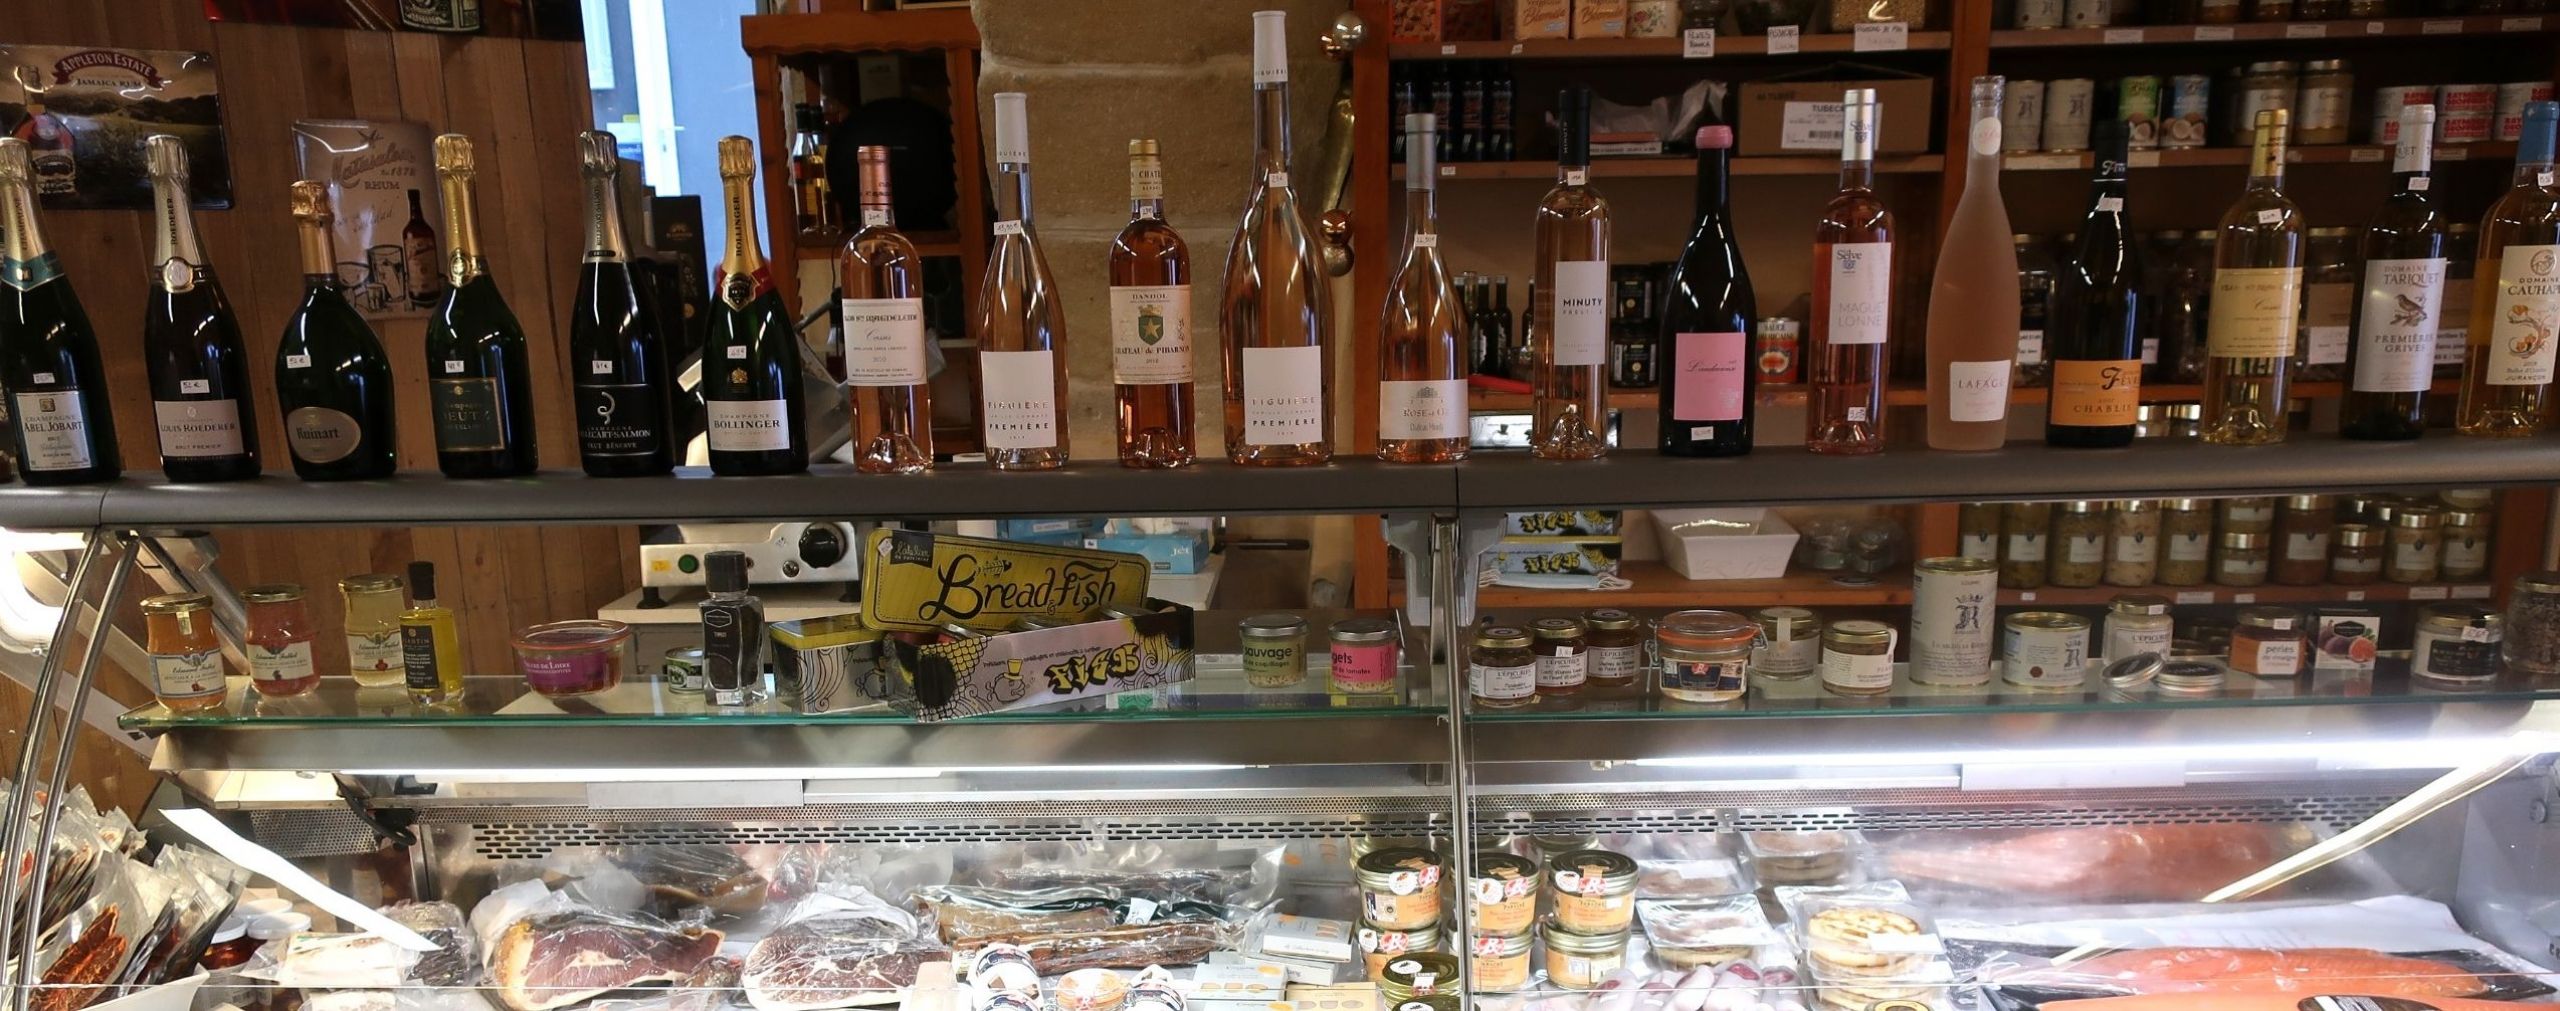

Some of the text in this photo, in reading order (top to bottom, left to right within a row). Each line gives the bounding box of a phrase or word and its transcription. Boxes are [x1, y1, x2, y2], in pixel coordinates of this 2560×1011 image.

[62, 51, 152, 77] APPLETON ESTATE
[76, 77, 117, 87] JAMAICA
[1813, 104, 1845, 113] TUBEC
[364, 180, 400, 190] RHUM
[166, 197, 177, 246] ROEDERER
[732, 197, 743, 257] BOLLINGER
[2384, 265, 2428, 273] DOMAINE
[2383, 273, 2440, 288] TARIQUET
[1563, 298, 1602, 307] MINUTY
[987, 400, 1049, 409] FIGUIÈRE
[25, 421, 83, 432] ABEL JOBART
[714, 419, 780, 429] BOLLINGER
[988, 422, 1049, 430] PREMIÈRE
[1252, 417, 1315, 427] PREMIÈRE
[183, 423, 235, 433] ROEDERER
[296, 427, 339, 440] Ruinart
